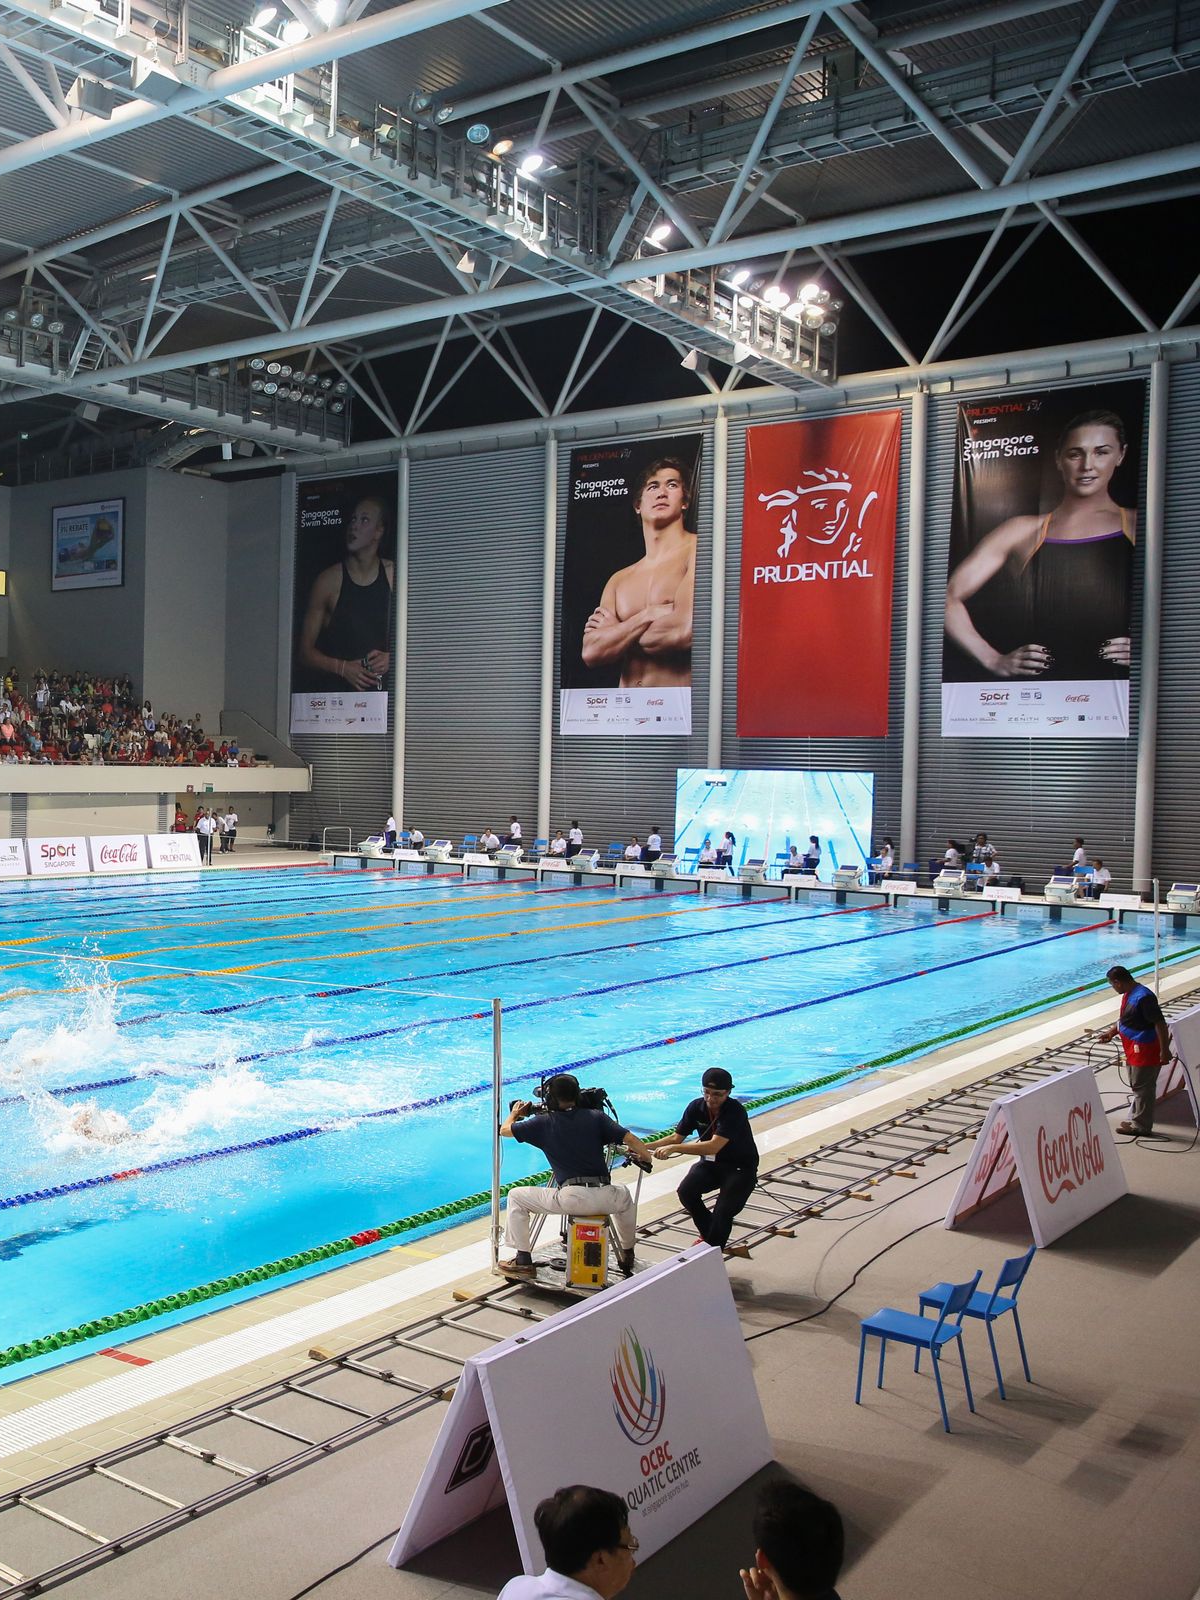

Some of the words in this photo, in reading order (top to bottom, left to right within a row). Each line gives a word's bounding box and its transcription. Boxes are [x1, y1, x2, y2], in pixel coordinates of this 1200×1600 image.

[965, 403, 1024, 416] PRUDENTIAL
[963, 434, 1034, 450] Singapore
[963, 448, 1000, 461] Swim
[1003, 445, 1039, 457] Stars
[574, 478, 625, 491] Singapore
[573, 489, 601, 500] Swim
[603, 486, 629, 497] Stars
[300, 518, 321, 528] Swim
[322, 517, 342, 526] Stars
[301, 509, 340, 520] Singapore
[753, 560, 873, 584] PRUDENTIAL
[979, 692, 1010, 701] Sport
[40, 843, 77, 860] Sport
[100, 843, 138, 864] Coca-Cola
[159, 854, 193, 862] PRUDENTIAL
[1037, 1102, 1104, 1204] Coca-Cola
[640, 1440, 673, 1477] OCBC
[623, 1470, 666, 1511] QUATIC
[665, 1447, 702, 1484] CENTRE
